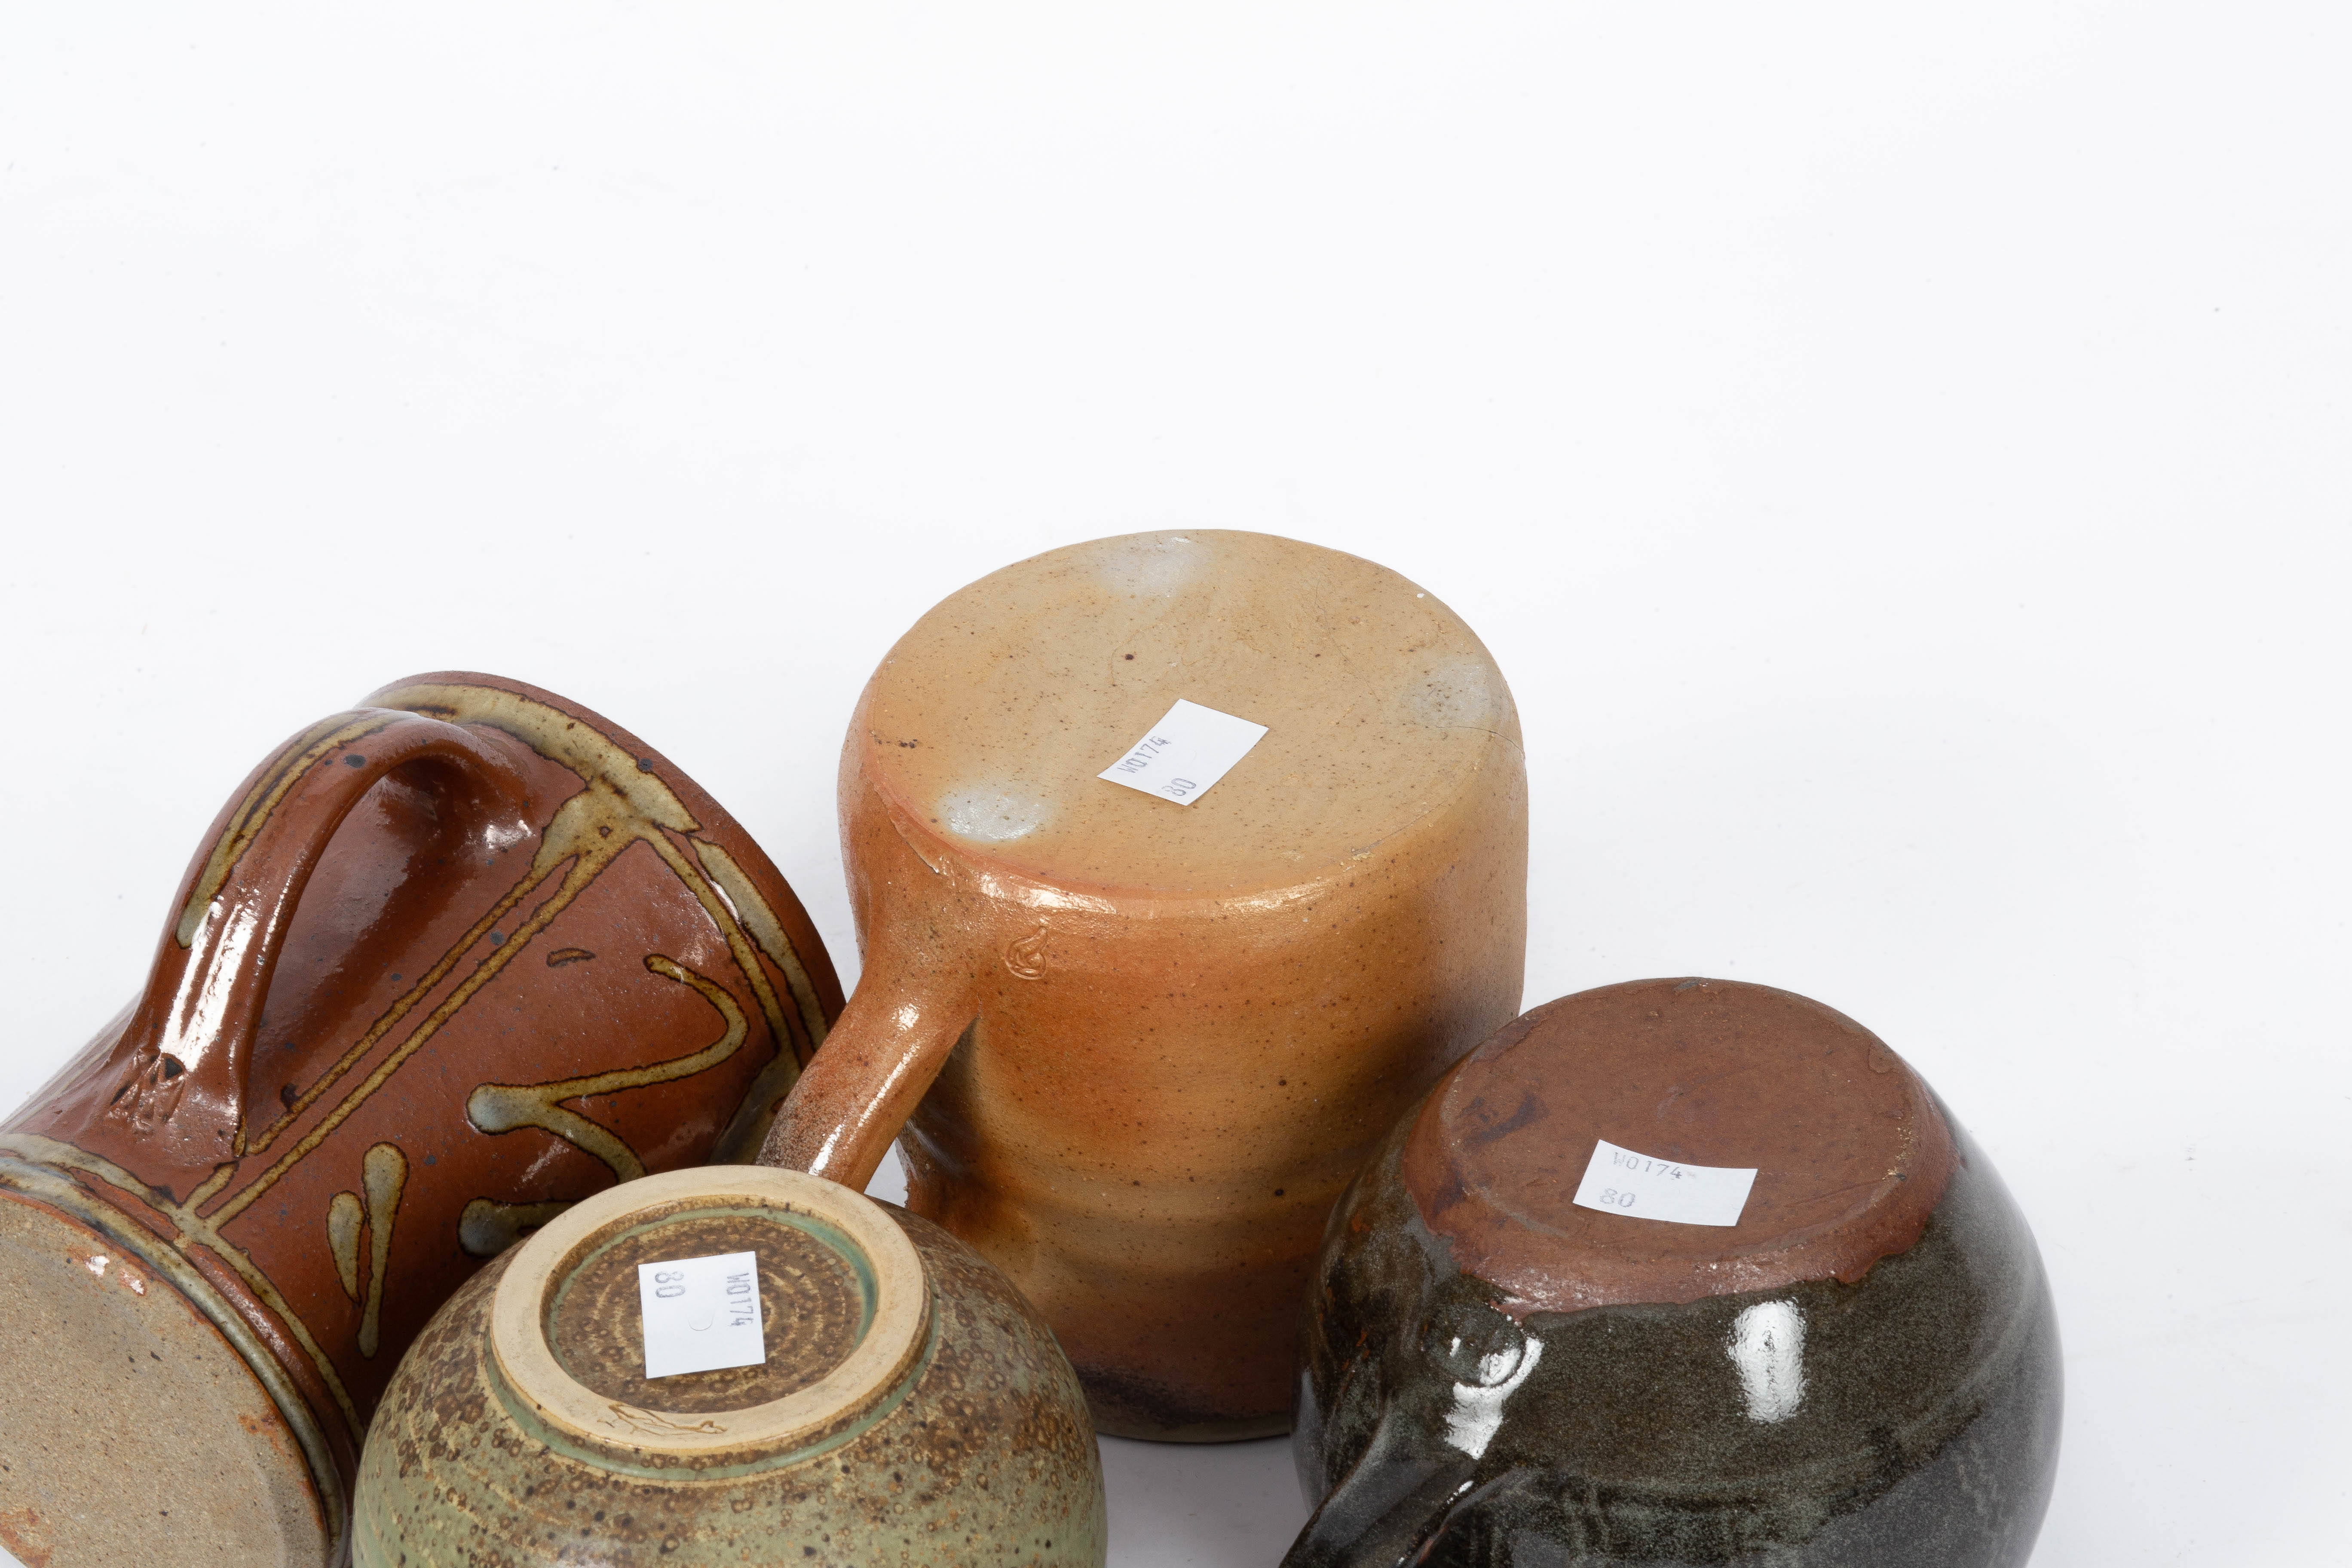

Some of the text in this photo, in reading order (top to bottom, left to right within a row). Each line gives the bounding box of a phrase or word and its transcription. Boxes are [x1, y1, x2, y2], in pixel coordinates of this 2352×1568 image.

[1161, 778, 1197, 796] 80
[1599, 1188, 1636, 1208] 80
[655, 1271, 686, 1298] 80
